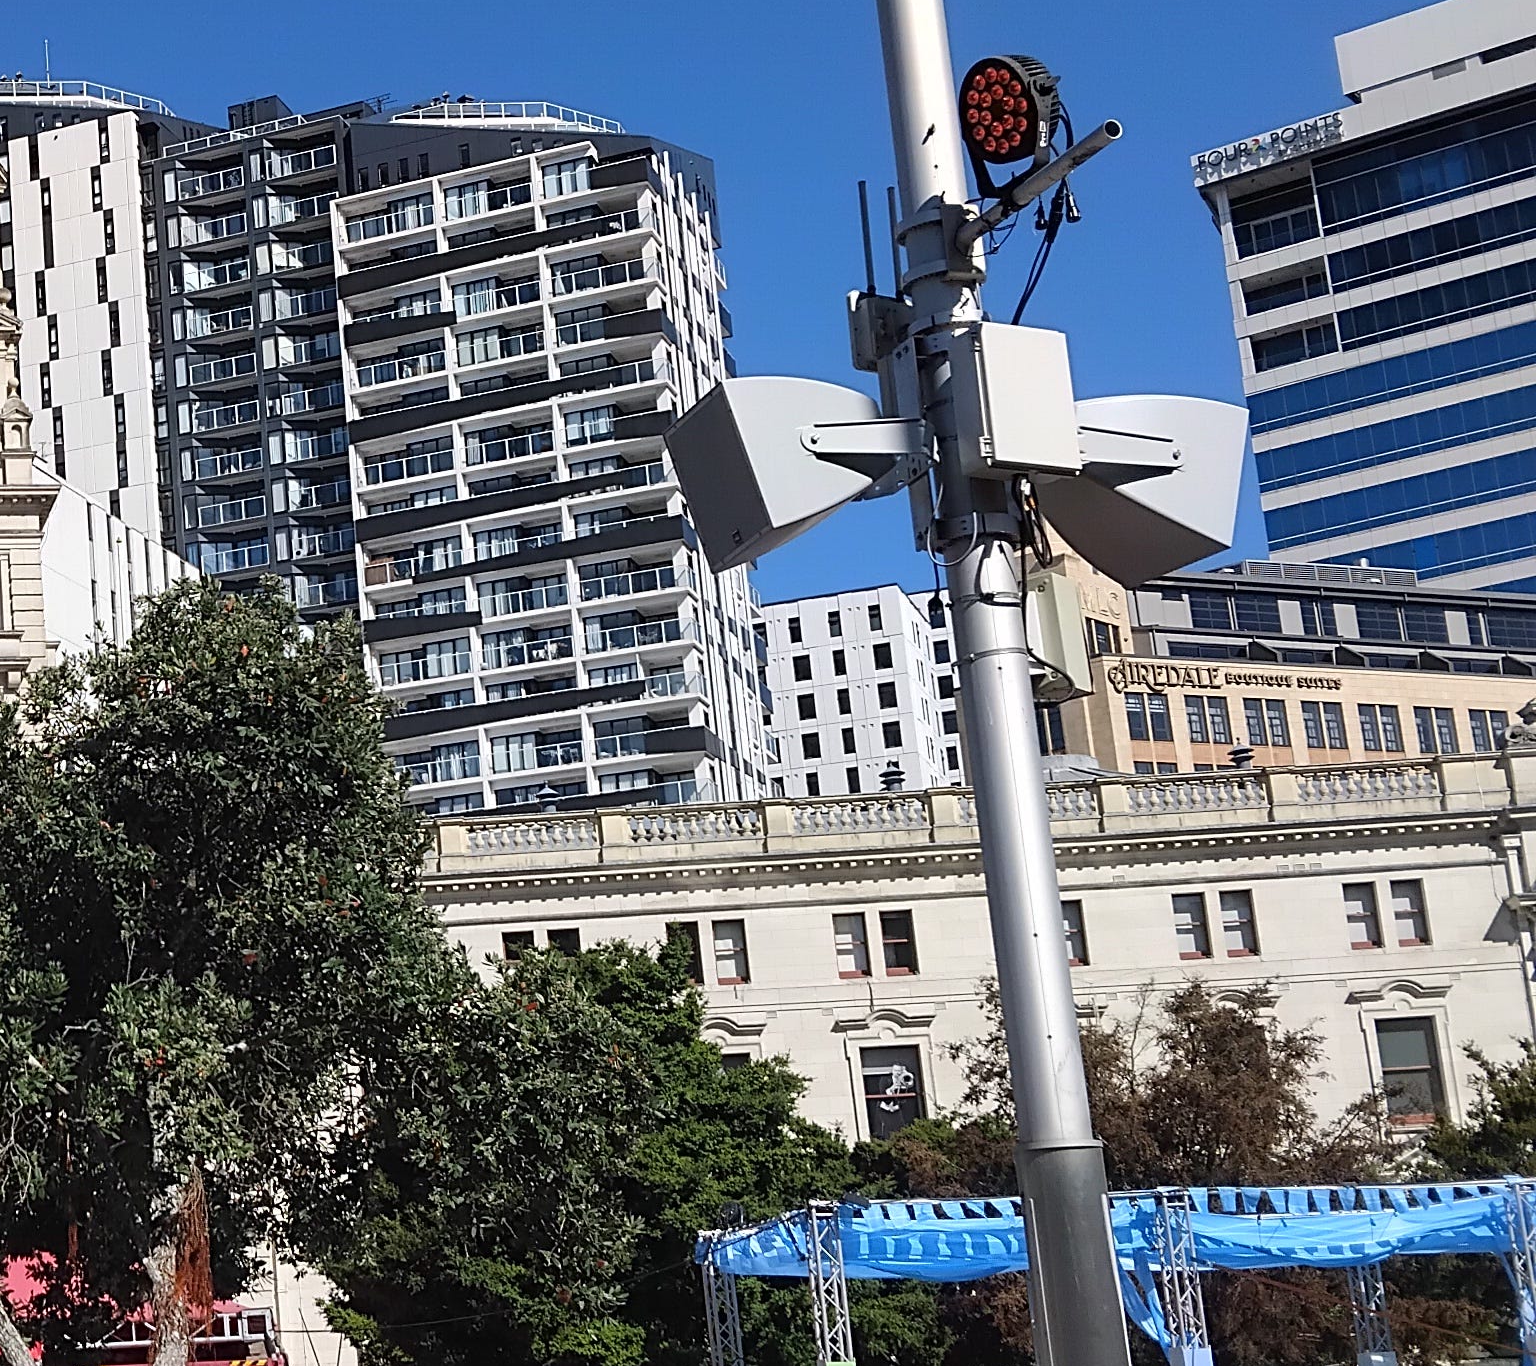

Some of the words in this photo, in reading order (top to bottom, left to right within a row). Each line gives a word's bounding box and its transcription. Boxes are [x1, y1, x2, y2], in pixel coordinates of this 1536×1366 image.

[1197, 142, 1251, 171] FOUR
[1270, 112, 1343, 148] POINTS
[1108, 658, 1223, 693] AIREDALE
[1225, 671, 1294, 688] BOUTIQUE
[1296, 675, 1343, 690] SUITES
